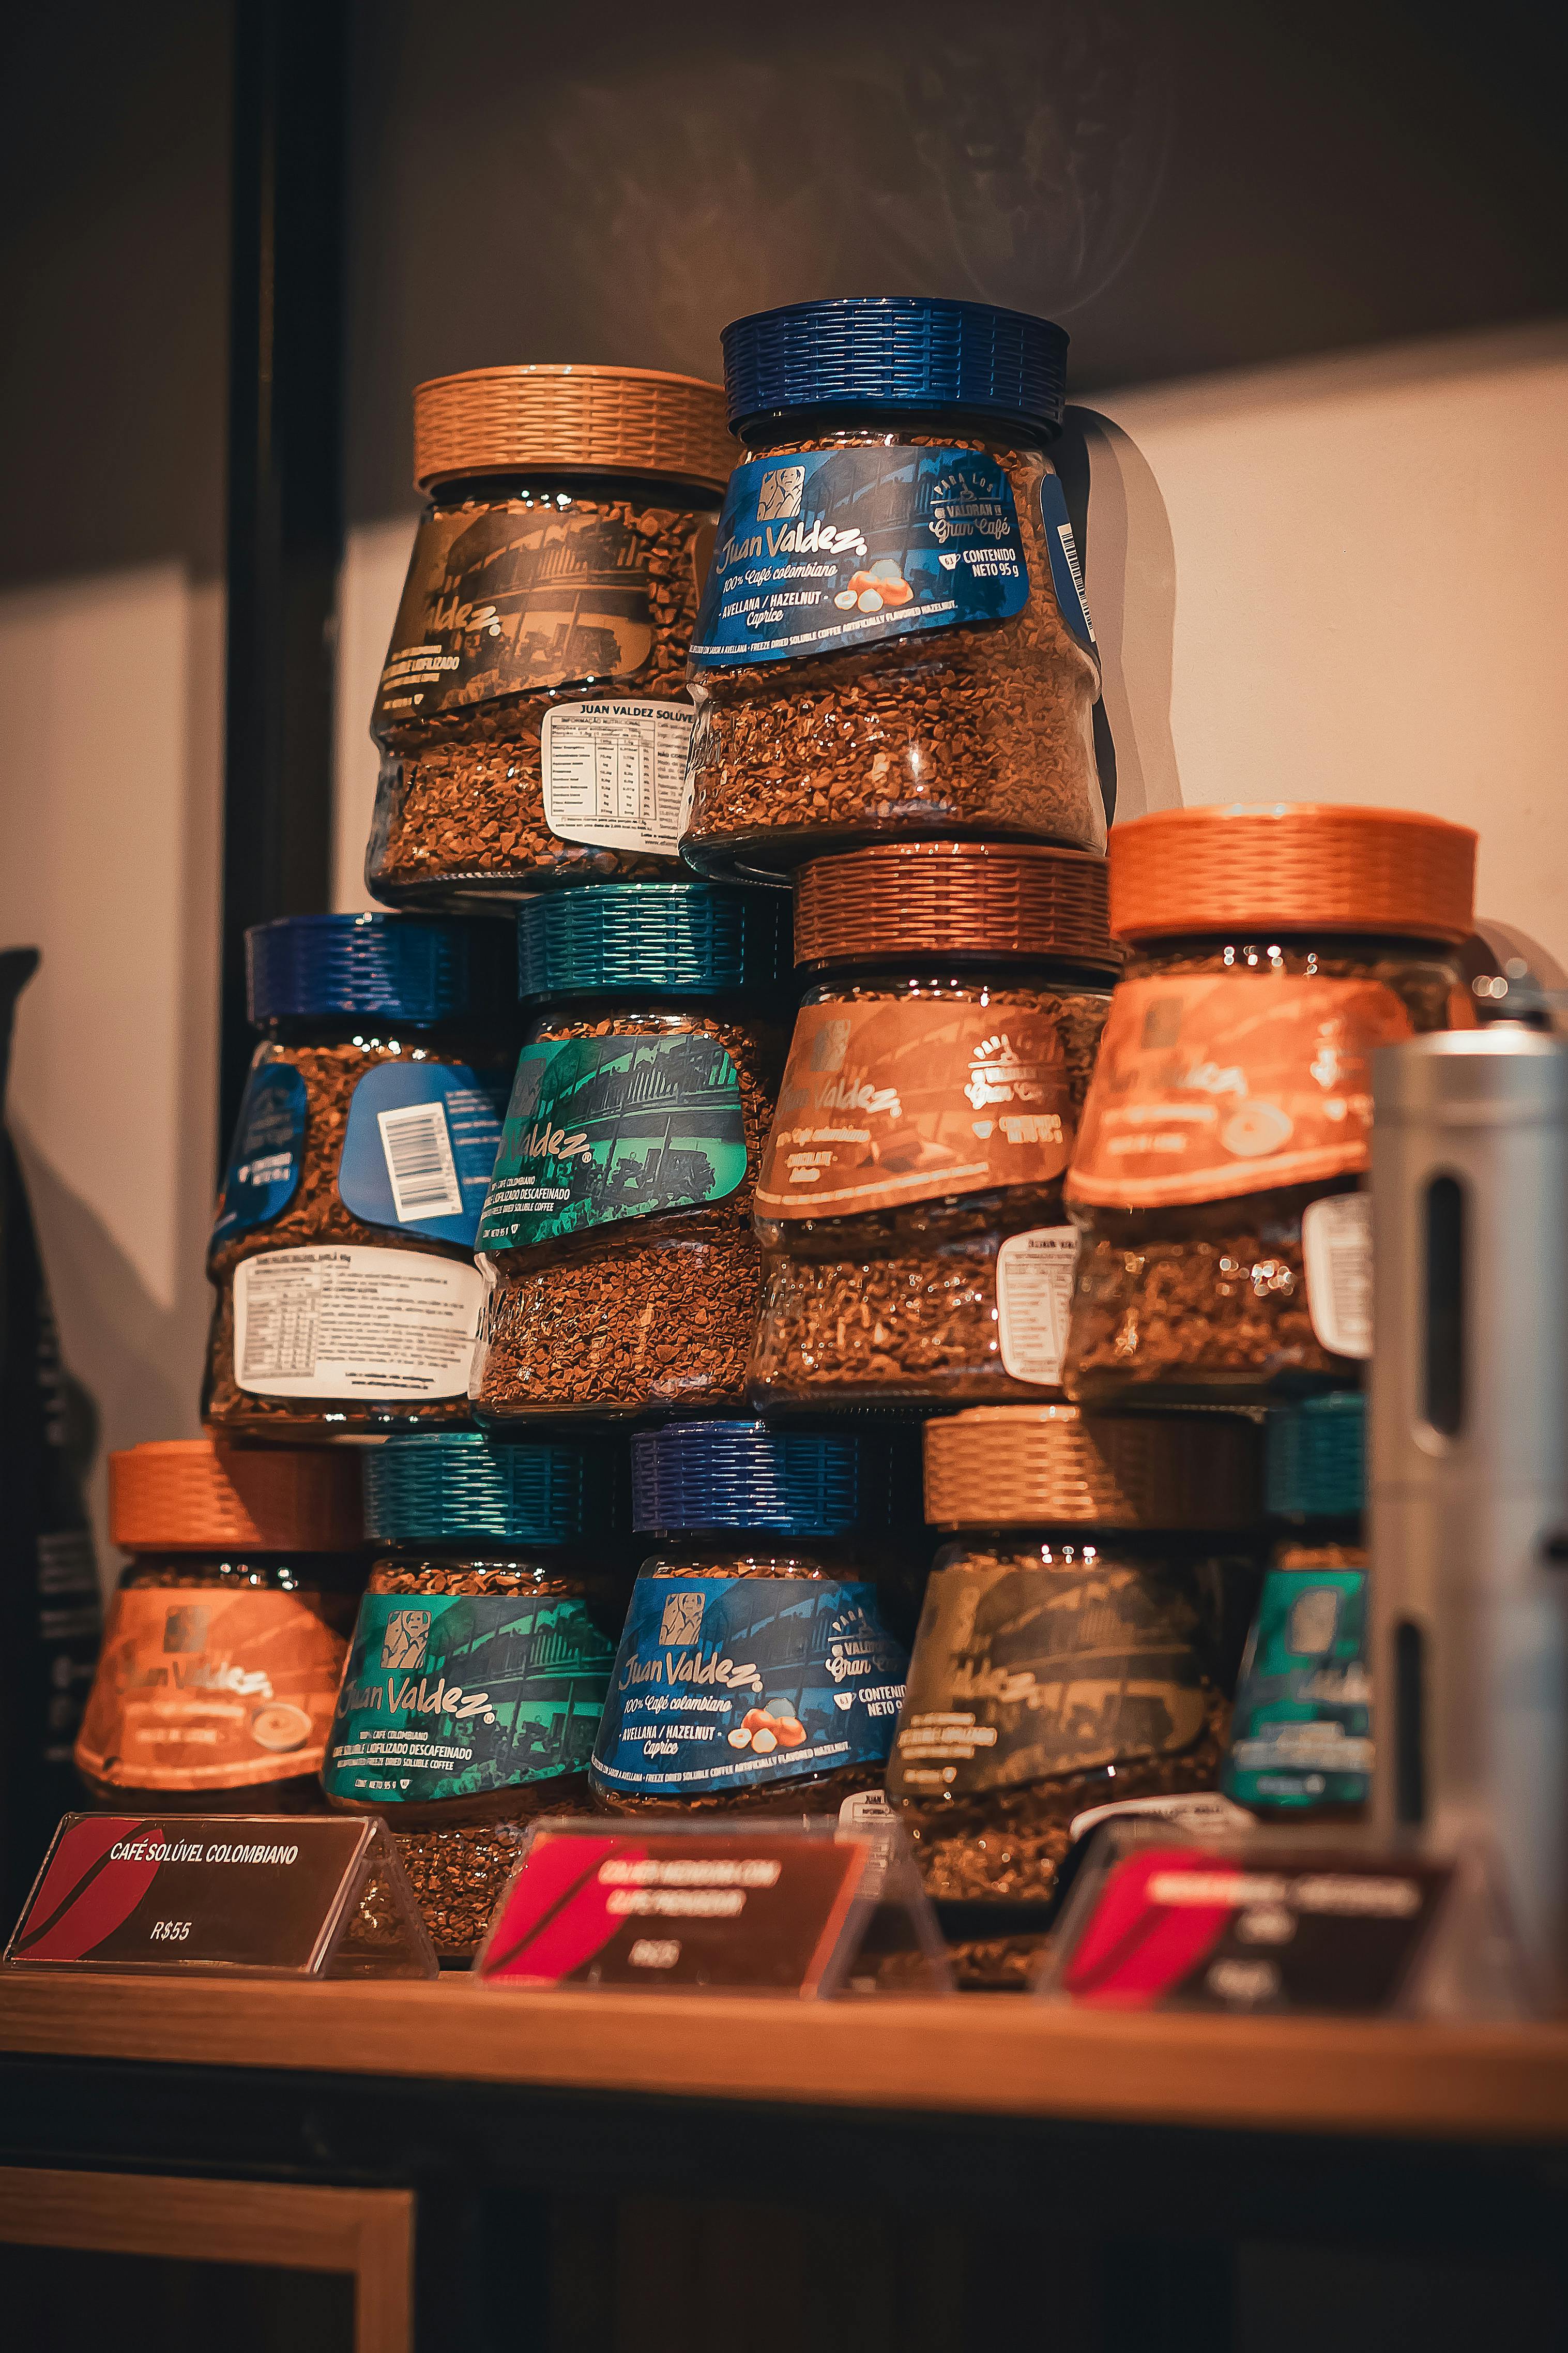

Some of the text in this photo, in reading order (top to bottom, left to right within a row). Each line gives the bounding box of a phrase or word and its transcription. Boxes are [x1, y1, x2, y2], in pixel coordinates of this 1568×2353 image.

[972, 473, 993, 492] LOS
[928, 517, 1011, 544] Gran Café
[716, 519, 865, 575] Juan Valdez
[963, 548, 1016, 564] CONTENIDO
[723, 562, 839, 594] 100% Café colombiano
[972, 563, 1019, 578] NETO 95 g
[722, 597, 760, 620] AVELLANA
[770, 591, 821, 608] HAZELNUT
[747, 607, 784, 629] Caprice
[580, 704, 610, 714] JUAN
[613, 706, 654, 718] VALDEZ
[520, 1188, 571, 1200] DESCAFEINADO
[534, 1202, 555, 1212] COFFEE
[618, 1651, 761, 1691] Juan Valdez
[825, 1656, 872, 1683] Gran
[338, 1677, 493, 1720] Juan Valdez
[624, 1694, 733, 1714] 100% Café colombiano
[867, 1700, 895, 1717] NETO
[622, 1726, 657, 1742] AVELLANA
[666, 1725, 716, 1741] HAZELNUT
[409, 1743, 473, 1761] DESCAFEINADO
[643, 1739, 679, 1759] Caprice
[110, 1838, 299, 1865] CAFÉ SOLÚVEL COLOMBIANO
[150, 1920, 192, 1941] R$55
